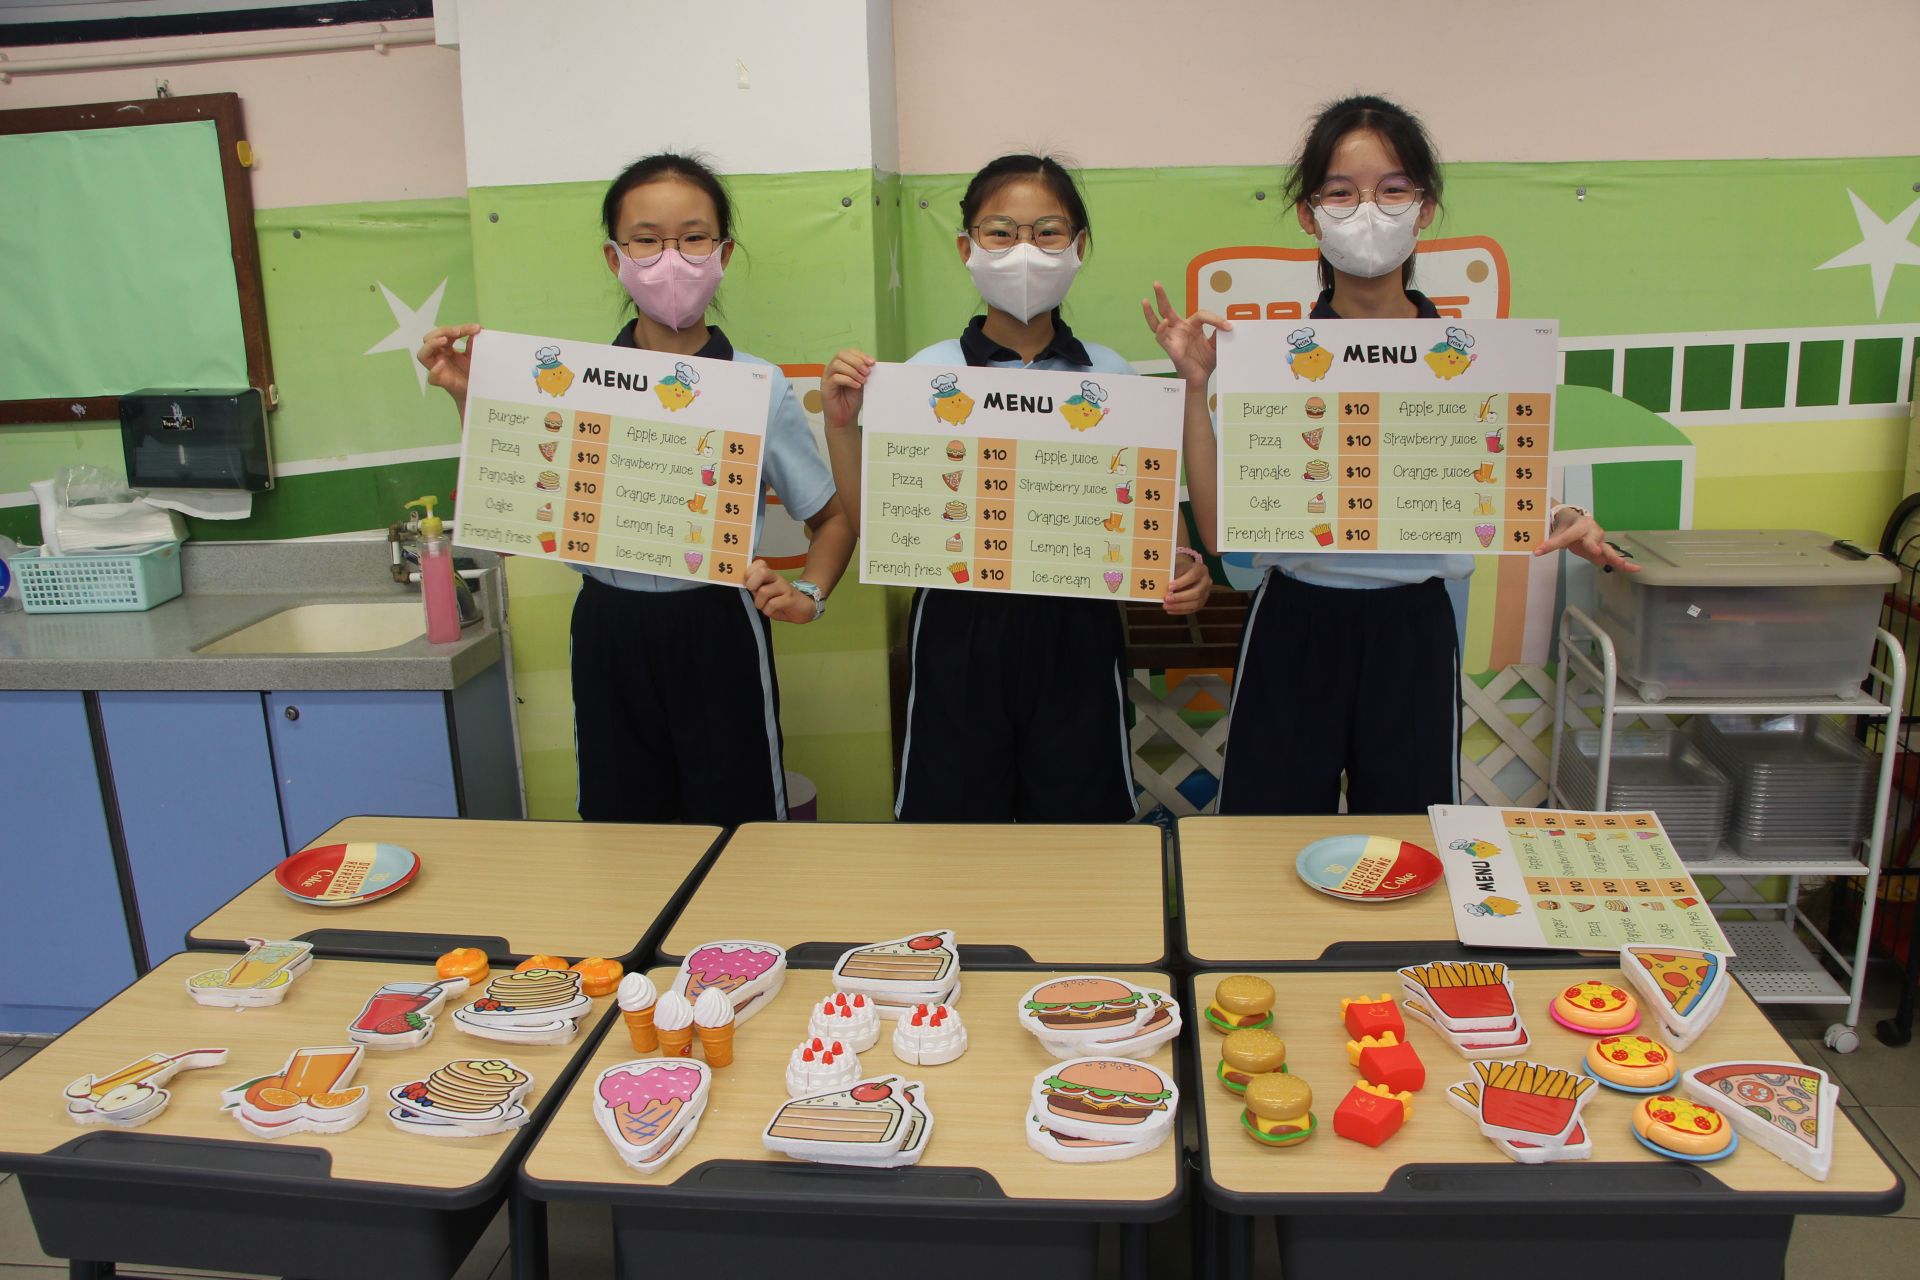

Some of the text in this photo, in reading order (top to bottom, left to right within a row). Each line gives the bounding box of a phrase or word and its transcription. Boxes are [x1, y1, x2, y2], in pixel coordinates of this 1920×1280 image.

[1298, 338, 1310, 347] HSN
[1450, 339, 1462, 348] HSN
[1343, 345, 1417, 364] MENU
[582, 367, 648, 392] MENU
[983, 392, 1053, 413] MENU
[1399, 402, 1467, 416] Apple juice
[1243, 402, 1287, 417] Burger
[1345, 404, 1369, 415] $10
[1516, 405, 1532, 416] $5
[488, 408, 530, 426] Burger
[579, 422, 601, 434] $10
[626, 426, 687, 445] Apple juice
[1249, 434, 1282, 448] Pizza
[1347, 435, 1371, 447] $10
[1384, 433, 1477, 447] Strawberry juice
[1517, 436, 1534, 448] $5
[491, 439, 520, 456] Pizza
[729, 443, 744, 455] $5
[887, 442, 930, 458] Burger
[577, 452, 599, 464] $10
[983, 449, 1007, 461] $10
[1035, 450, 1098, 466] Apple juice
[610, 453, 693, 476] Strawberry juice
[1144, 459, 1160, 470] $5
[479, 467, 525, 485] Pancake
[1240, 465, 1291, 480] Pancake
[1346, 466, 1371, 478] $10
[1393, 465, 1471, 480] Orange juice
[1516, 468, 1532, 479] $5
[728, 473, 742, 485] $5
[892, 473, 923, 488] Pizza
[984, 479, 1008, 491] $10
[574, 481, 596, 494] $10
[1019, 479, 1108, 496] Strawberry juice
[616, 486, 685, 506] Orange juice
[1145, 489, 1161, 500] $5
[485, 497, 514, 513] Cake
[725, 503, 740, 515] $5
[882, 502, 931, 517] Pancake
[1250, 497, 1281, 510] Cake
[1348, 498, 1373, 509] $10
[1397, 497, 1461, 511] Lemon tea
[1517, 499, 1534, 511] $5
[573, 511, 594, 524] $10
[983, 509, 1006, 522] $10
[1028, 510, 1101, 527] Orange juice
[616, 515, 674, 536] Lemon tea
[1143, 519, 1159, 530] $5
[463, 523, 531, 544] French fries
[723, 533, 738, 544] $5
[891, 532, 921, 546] Cake
[1227, 527, 1304, 542] French fries
[1346, 529, 1370, 541] $10
[1400, 529, 1462, 543] Ice-cream
[1514, 531, 1530, 542] $5
[568, 540, 590, 552] $10
[984, 539, 1007, 551] $10
[1030, 540, 1091, 557] Lemon tea
[616, 546, 672, 567] Ice-cream
[1143, 549, 1159, 561] $5
[718, 562, 733, 574] $5
[869, 561, 942, 576] French fries
[981, 569, 1004, 581] $10
[1032, 571, 1091, 588] Ice-cream
[1140, 579, 1155, 590] $5
[1515, 817, 1526, 825] $5
[1545, 817, 1556, 825] $5
[1575, 818, 1587, 826] $5
[1604, 818, 1616, 826] $5
[1634, 818, 1646, 826] $5
[302, 870, 334, 887] Coke
[343, 862, 370, 894] DELICIOUS
[1342, 858, 1376, 890] DELICIOUS
[1472, 861, 1496, 892] MENU
[1382, 873, 1417, 889] Coke
[1570, 881, 1584, 892] $10
[1604, 881, 1619, 893] $10
[1636, 880, 1650, 892] $10
[1670, 881, 1685, 893] $10
[1537, 881, 1551, 895] $10
